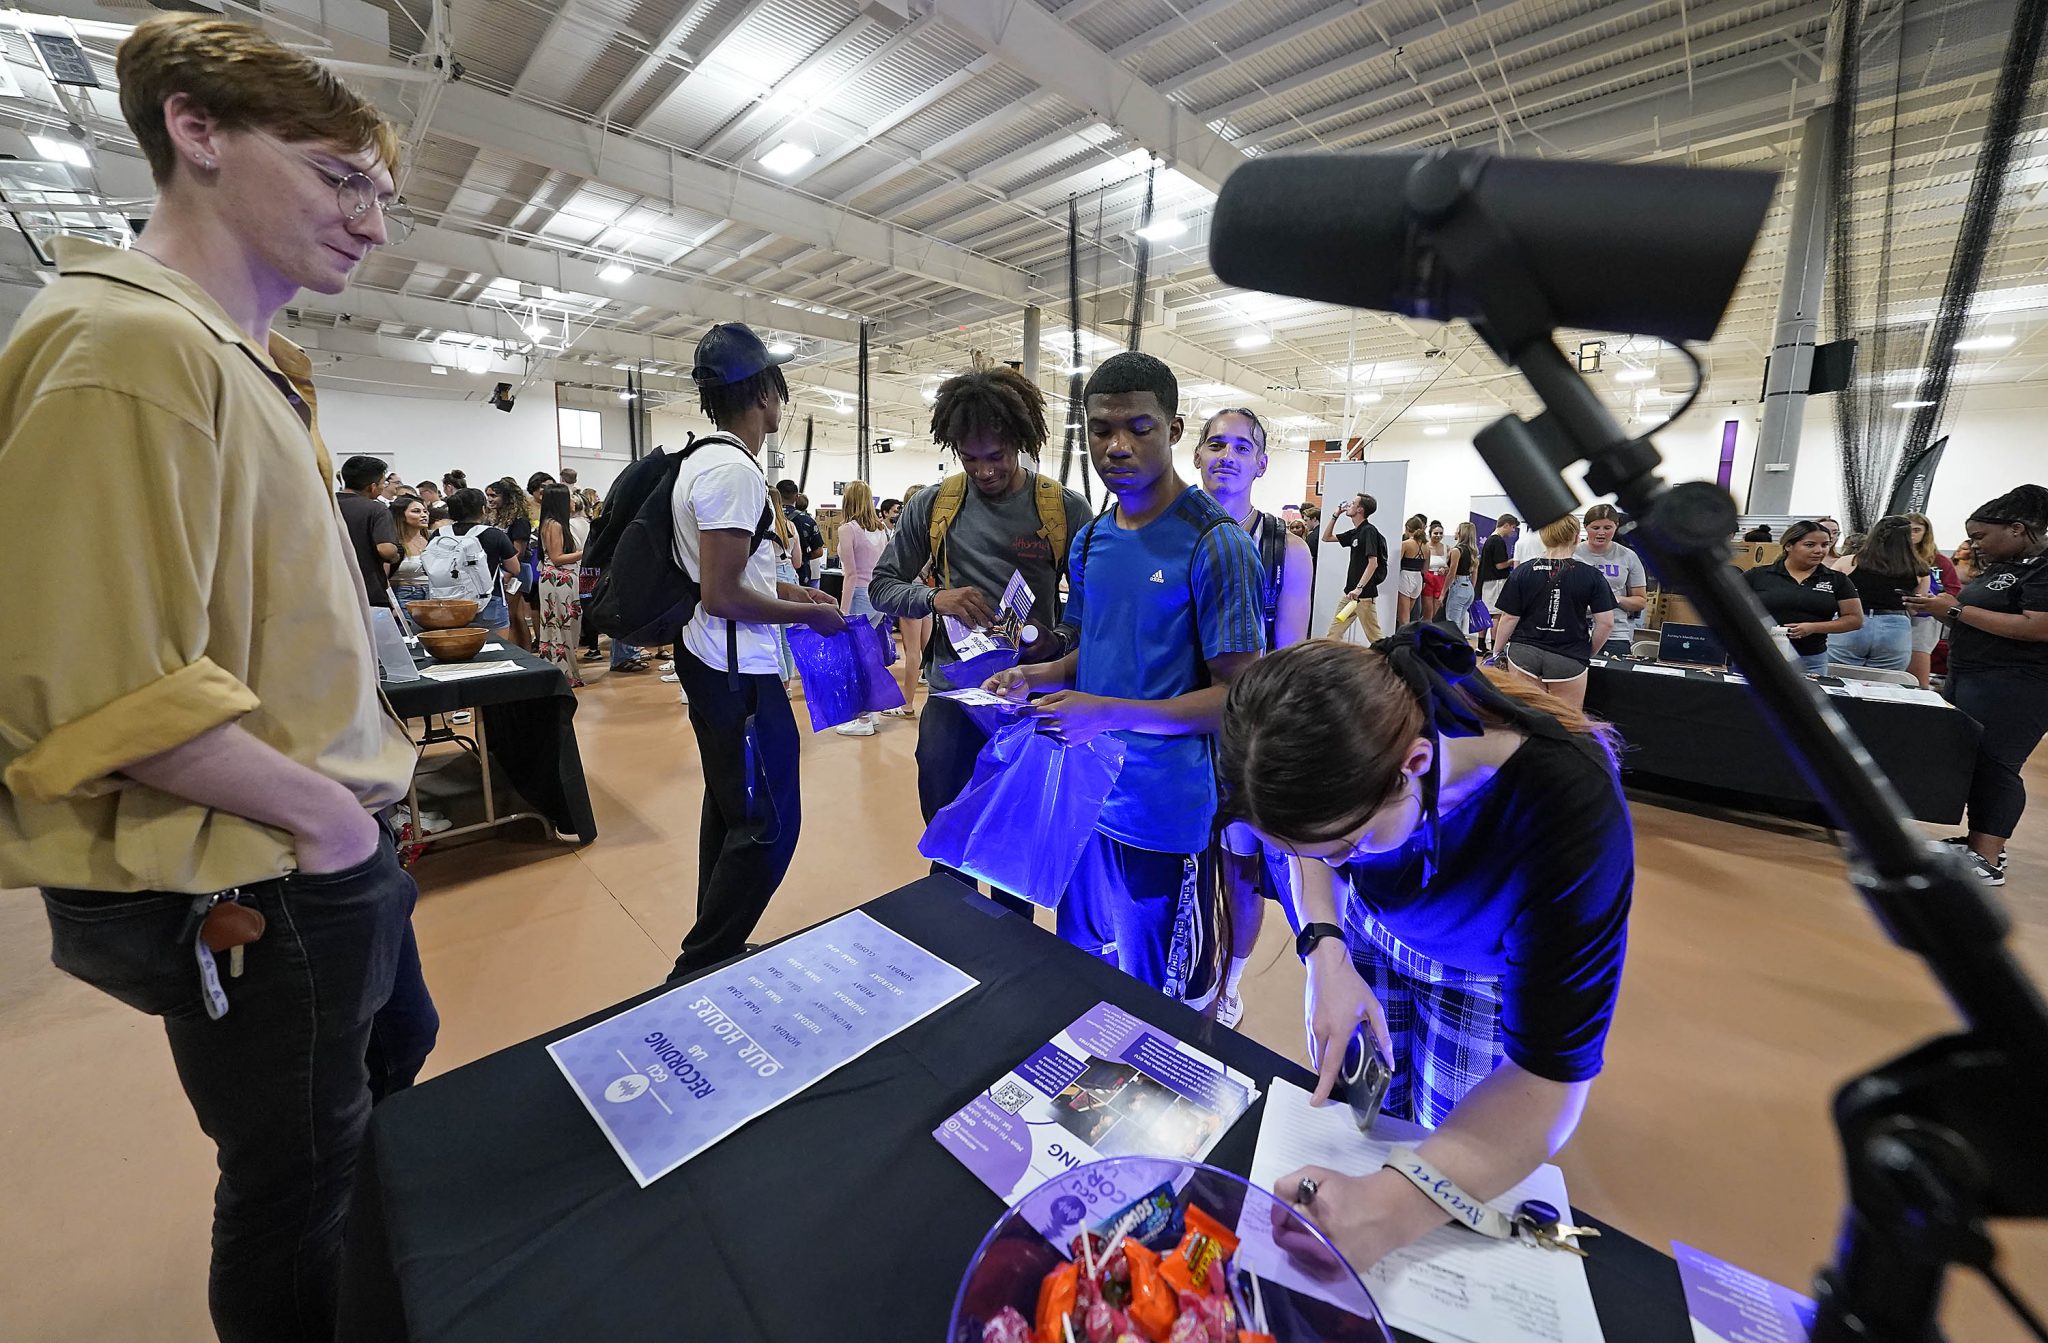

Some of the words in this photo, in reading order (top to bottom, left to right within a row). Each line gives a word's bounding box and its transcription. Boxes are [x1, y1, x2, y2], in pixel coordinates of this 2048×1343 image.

[851, 941, 876, 957] CLOSED
[766, 966, 784, 978] 12AM
[885, 963, 914, 981] SUNDAY
[726, 985, 744, 998] 12AM
[851, 980, 877, 998] FRIDAY
[868, 972, 904, 995] SATURDAY
[764, 989, 784, 1003] 10AM
[832, 990, 867, 1015] THURSDAY
[743, 1000, 762, 1014] 10AM
[812, 1000, 854, 1031] WEDNESDAY
[687, 997, 744, 1045] HOURS
[792, 1010, 823, 1034] TUESDAY
[770, 1022, 802, 1047] MONDAY
[686, 1043, 709, 1061] LAB
[1077, 1036, 1108, 1058] POSSIBILITIES
[642, 1029, 715, 1100] RECORDING
[735, 1042, 781, 1079] OUR
[1022, 1063, 1040, 1076] students
[645, 1063, 669, 1083] GCU
[1033, 1063, 1058, 1081] opportunity
[1033, 1077, 1055, 1094] PURPOSE
[957, 1110, 976, 1126] OPEN
[1008, 1139, 1024, 1152] Mon
[1072, 1180, 1098, 1204] GCU
